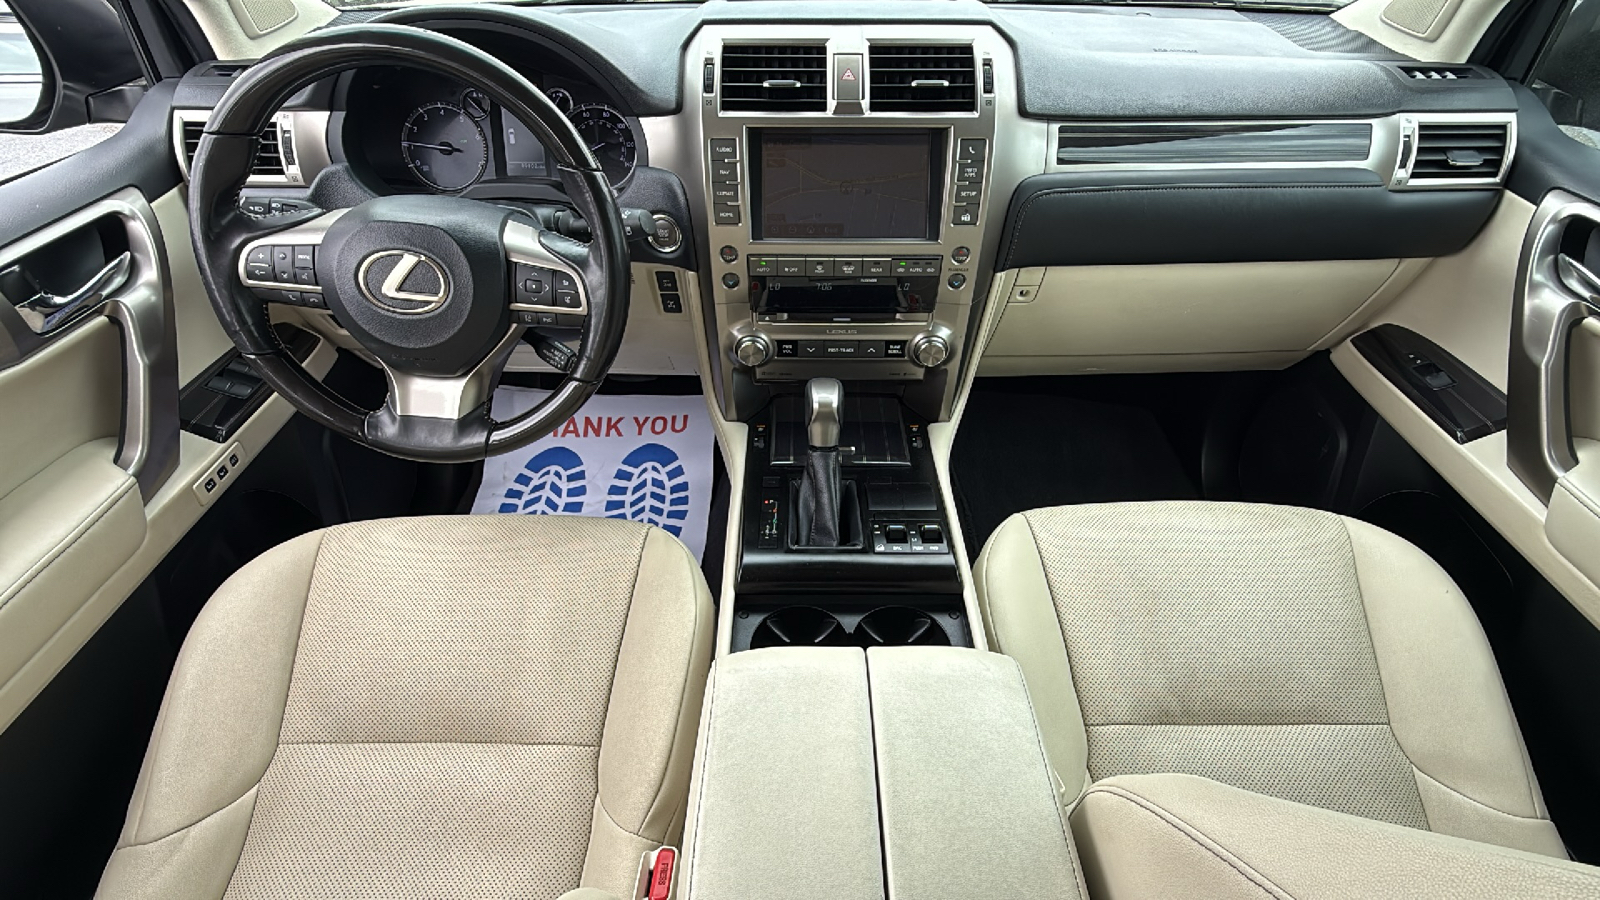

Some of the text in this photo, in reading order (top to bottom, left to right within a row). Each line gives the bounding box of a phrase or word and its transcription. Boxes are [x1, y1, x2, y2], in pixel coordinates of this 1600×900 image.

[423, 113, 429, 121] 3
[459, 115, 465, 123] 5
[633, 414, 689, 436] YOU
